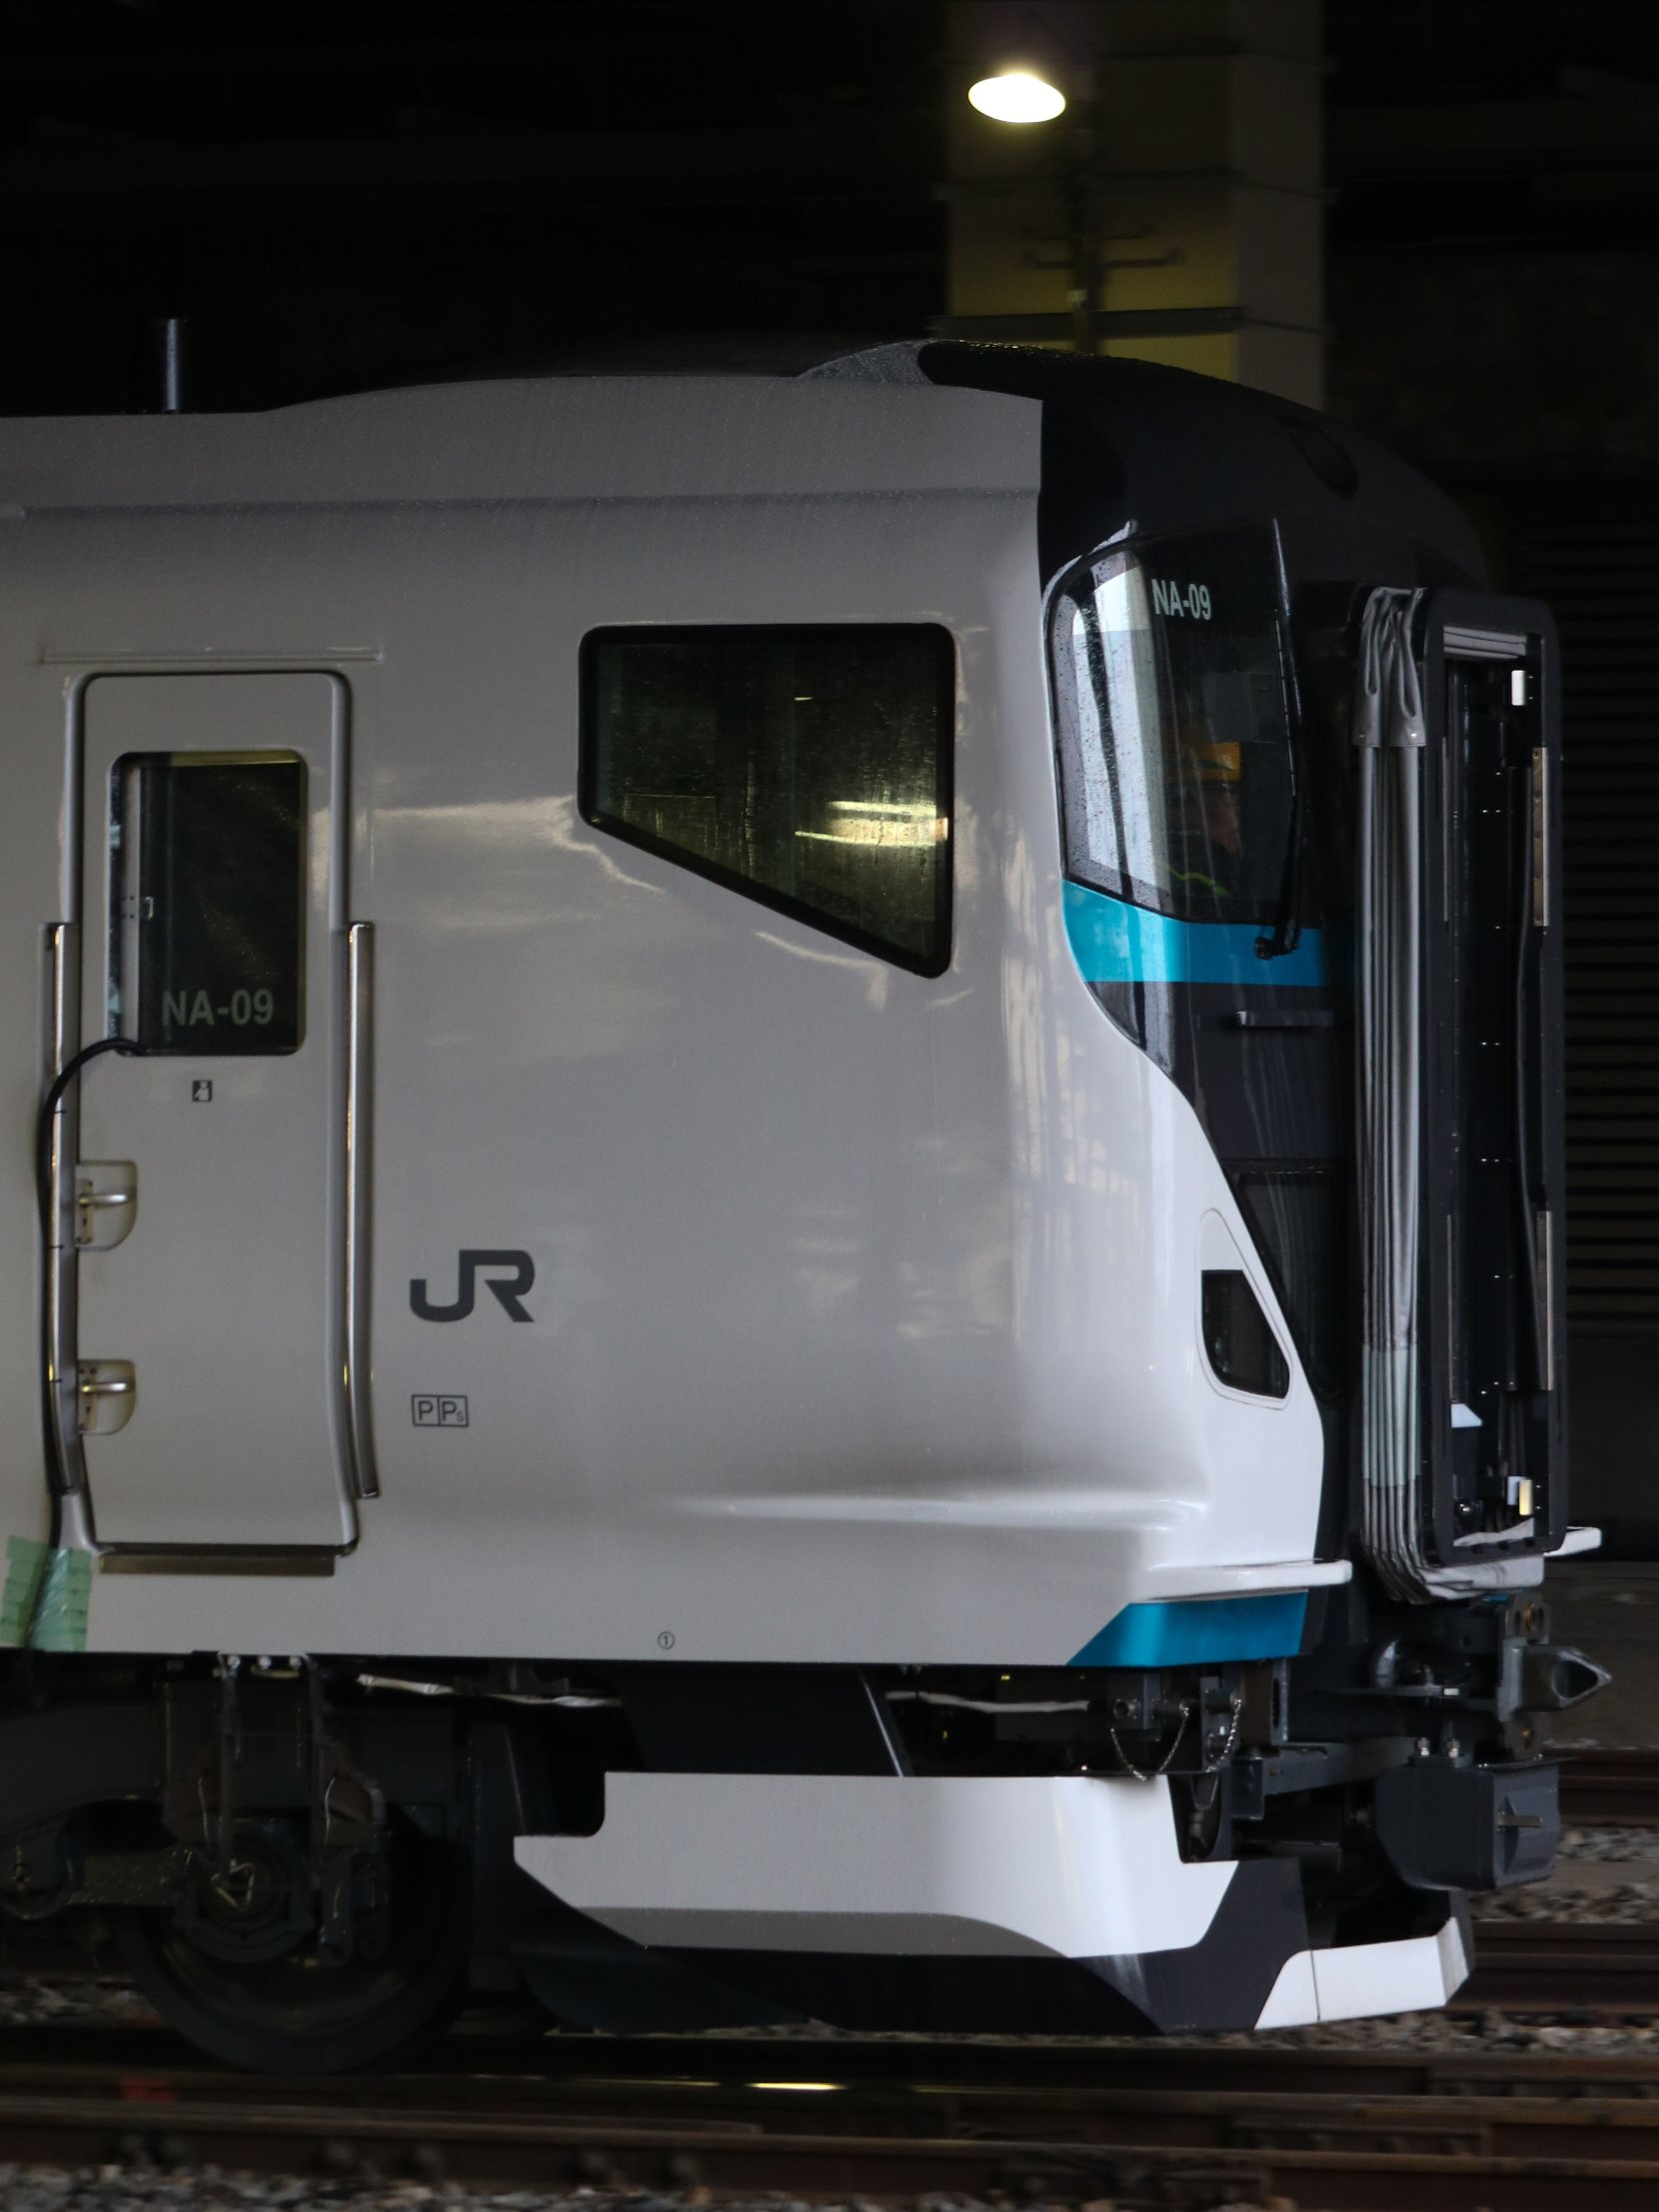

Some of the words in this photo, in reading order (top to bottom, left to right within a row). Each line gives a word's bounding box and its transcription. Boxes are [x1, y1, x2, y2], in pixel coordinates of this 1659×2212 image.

[1151, 579, 1211, 621] NA-09
[162, 989, 274, 1026] NA-09
[410, 1249, 536, 1322] JR
